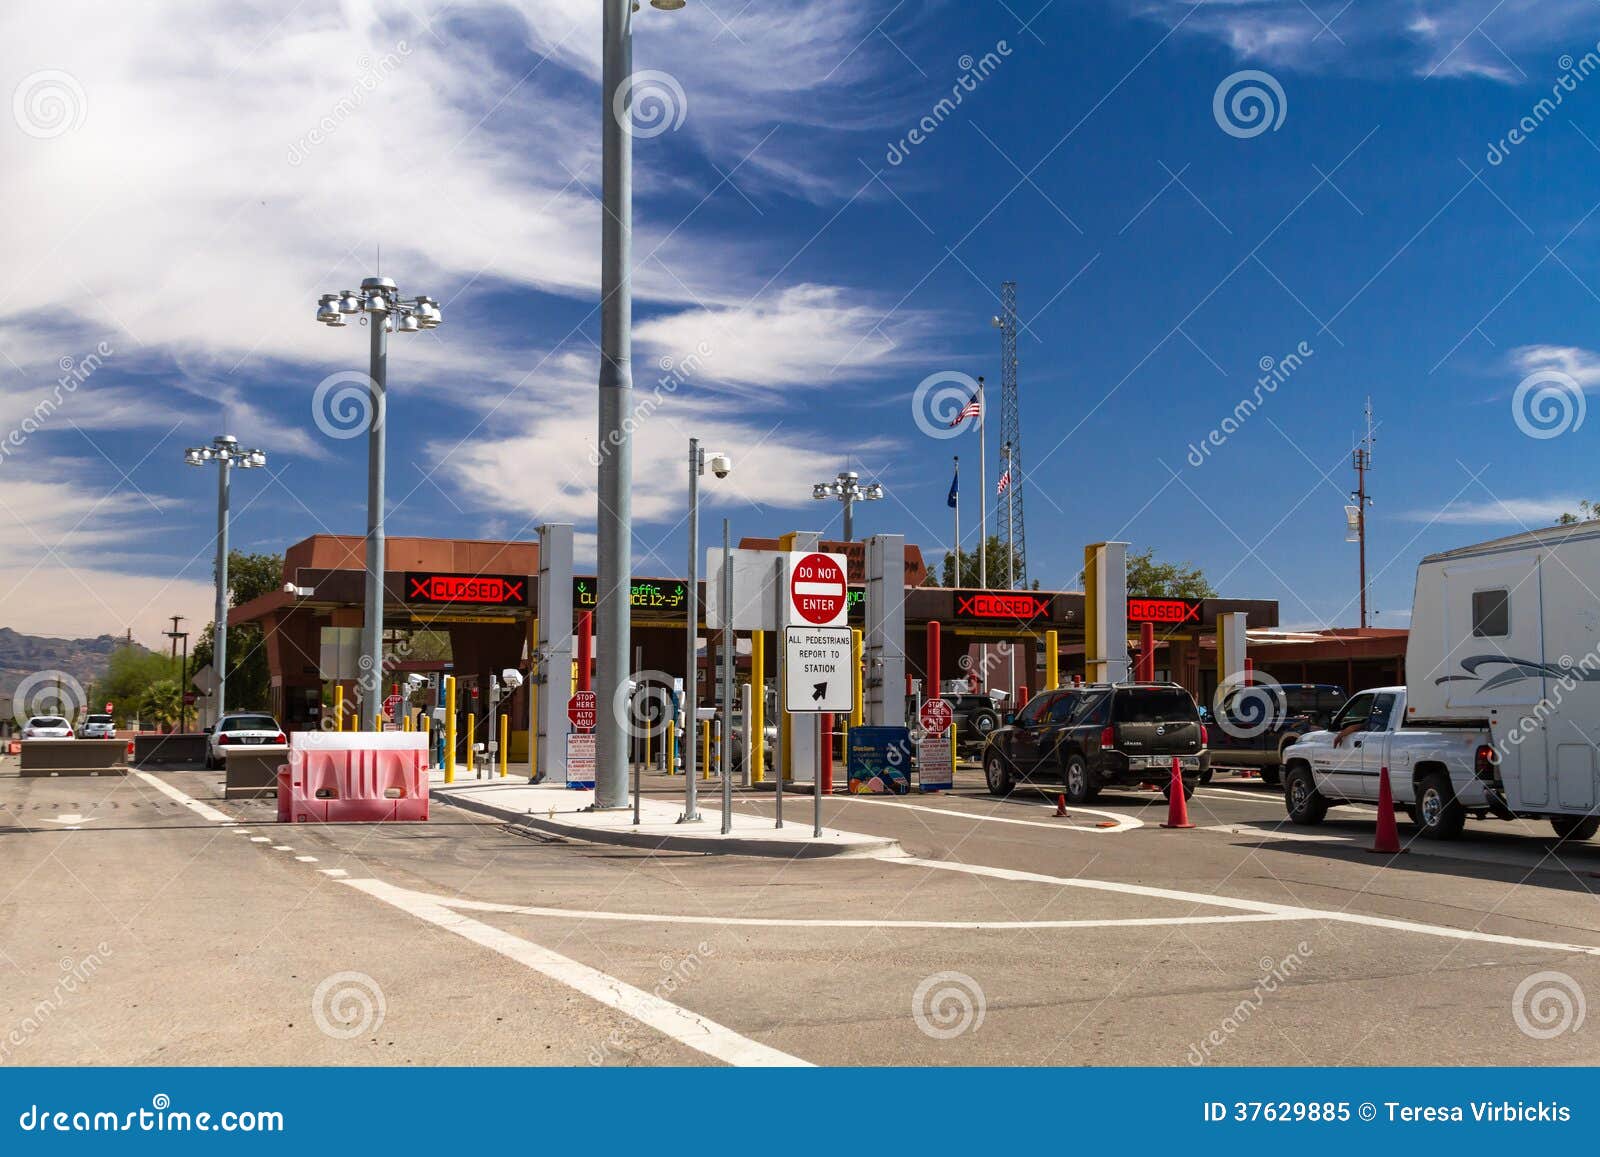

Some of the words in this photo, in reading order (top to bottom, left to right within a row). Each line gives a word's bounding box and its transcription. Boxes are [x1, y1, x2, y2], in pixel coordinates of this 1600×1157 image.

[799, 567, 813, 578] DO
[817, 568, 837, 579] NOT
[432, 579, 502, 600] CLOSED
[803, 598, 835, 611] ENTER
[975, 598, 1033, 615] CLOSED
[1131, 603, 1183, 620] CLOSED
[789, 635, 802, 644] ALL
[805, 636, 850, 645] PEDESTRIANS
[799, 650, 826, 658] REPORT
[830, 650, 840, 659] TO
[804, 664, 836, 673] STATION
[576, 701, 595, 709] HERE
[576, 711, 593, 719] ALTO
[576, 719, 593, 727] AQUI
